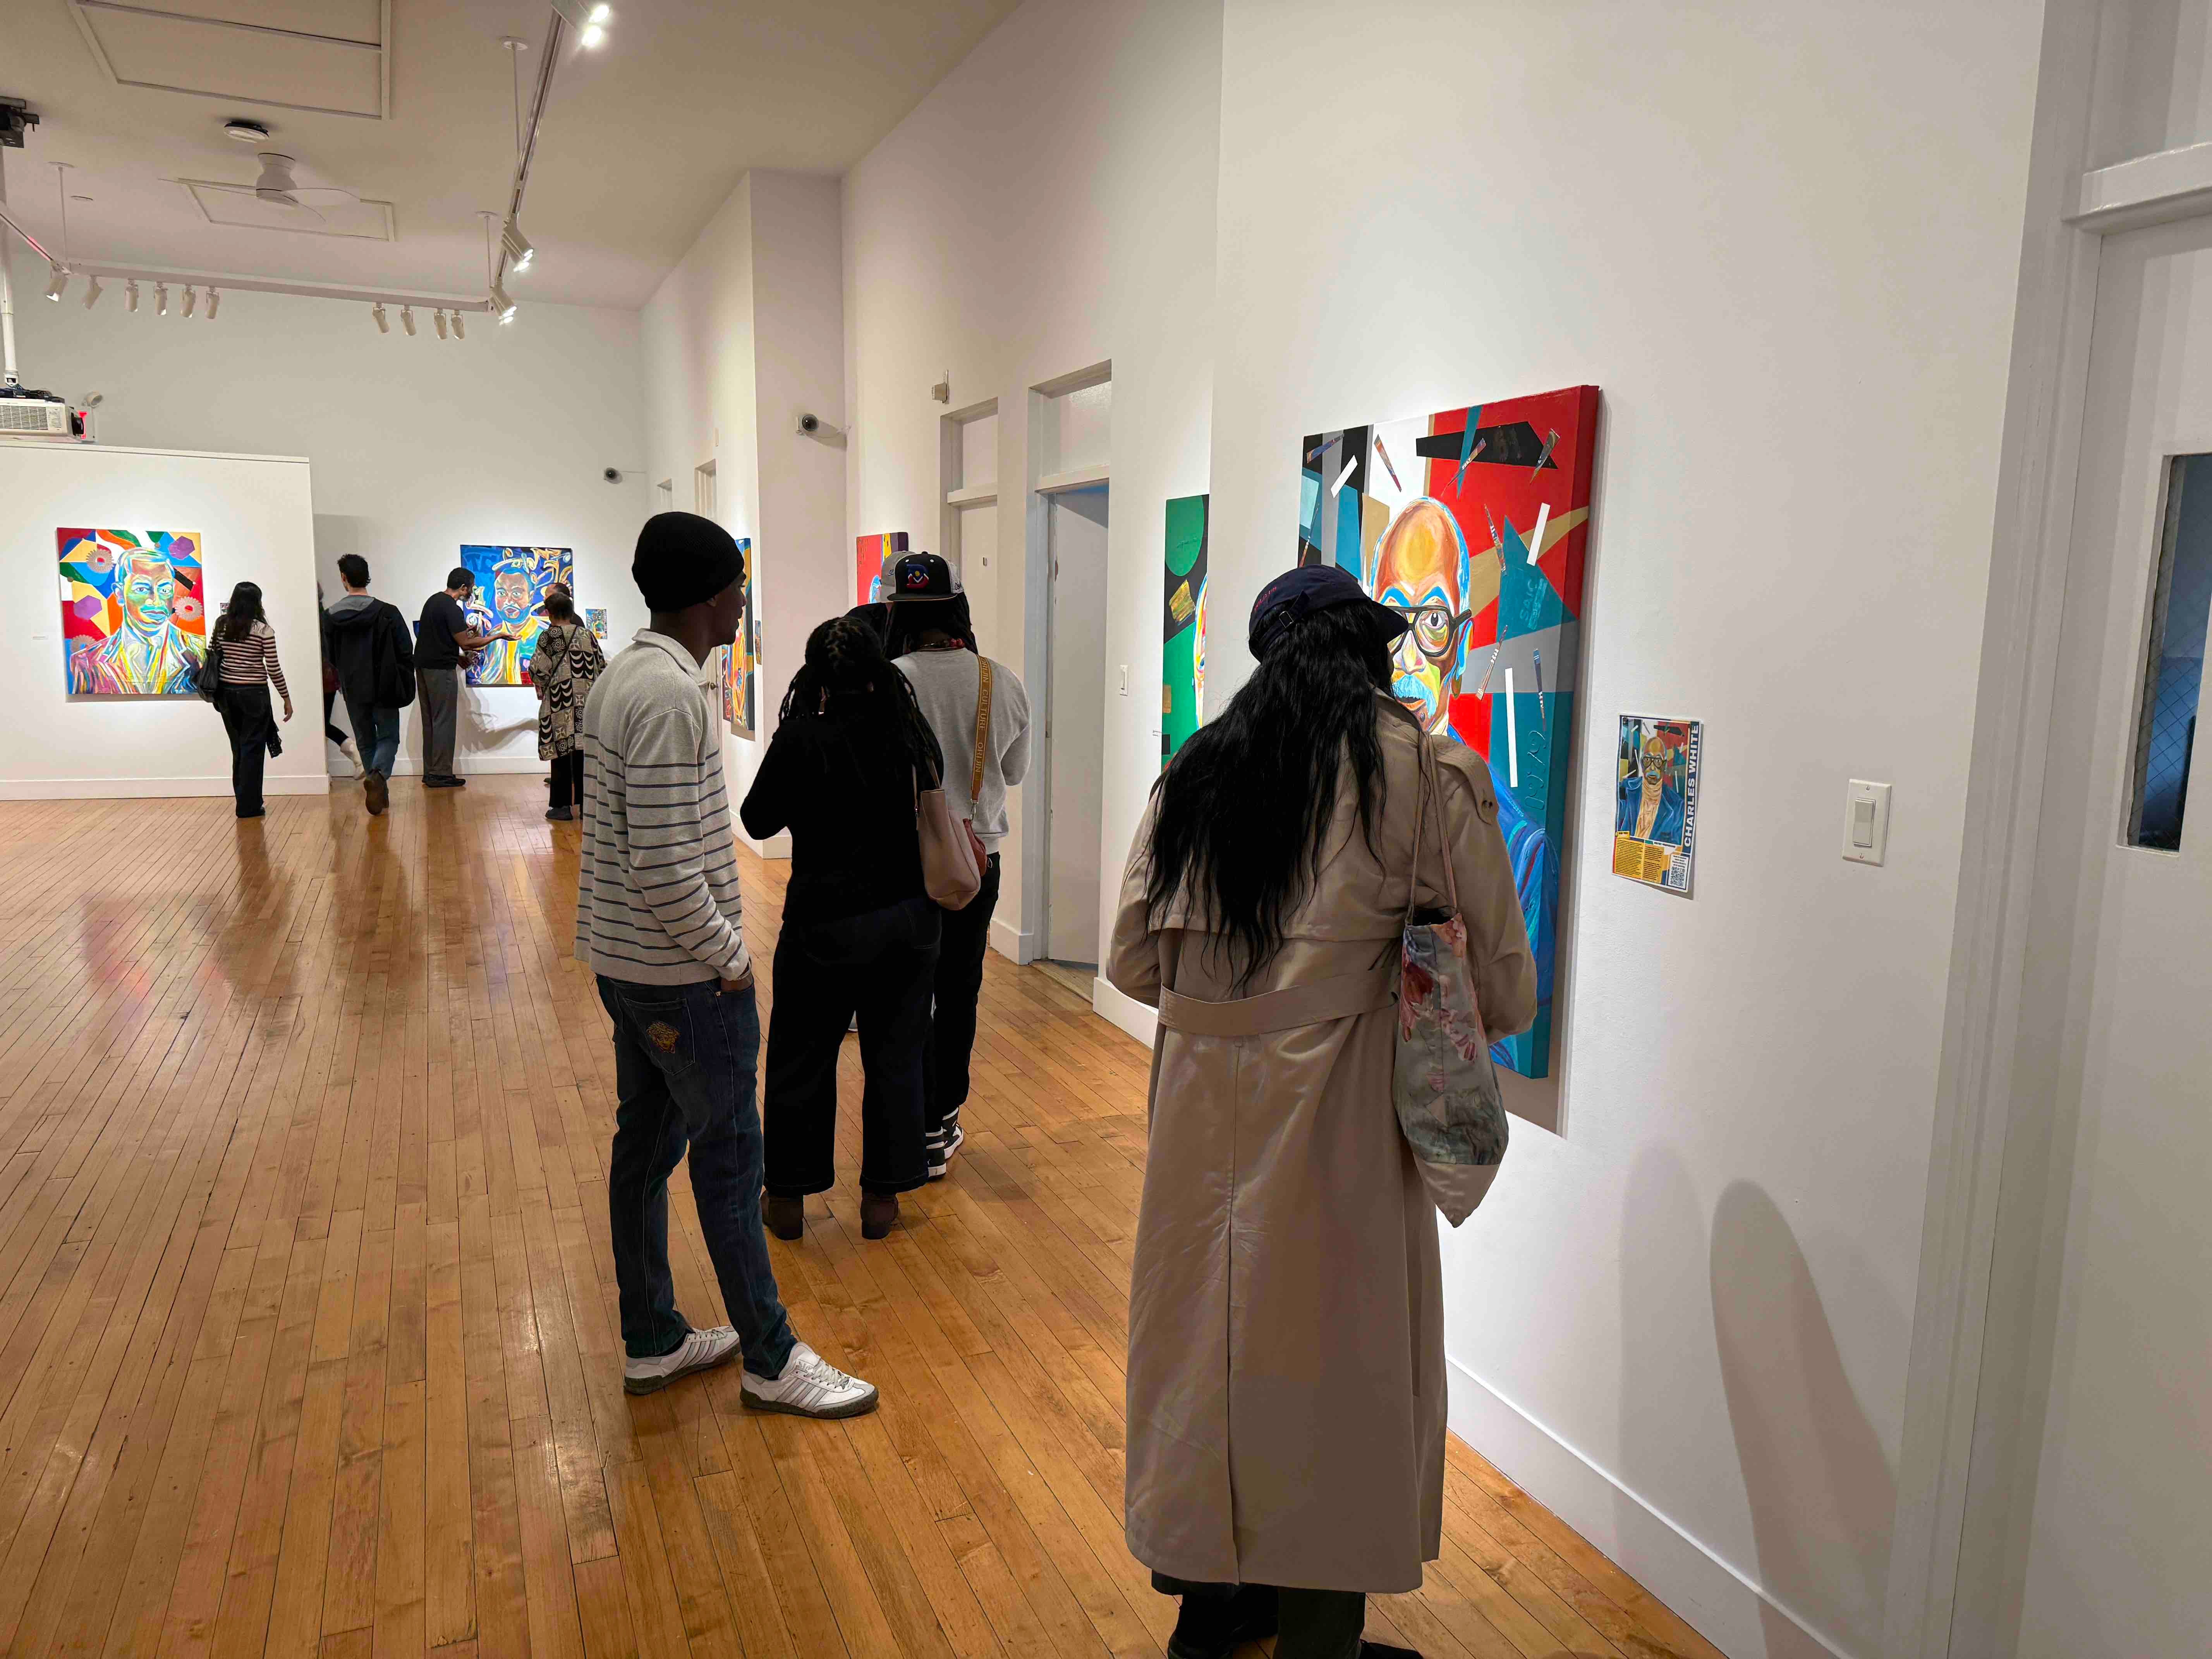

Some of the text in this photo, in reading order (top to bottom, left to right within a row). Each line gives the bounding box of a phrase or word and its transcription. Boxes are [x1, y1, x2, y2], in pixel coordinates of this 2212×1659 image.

[978, 689, 988, 730] CULTURE
[975, 742, 984, 773] ORIJIN
[1684, 724, 1698, 847] CHARLES WHITE
